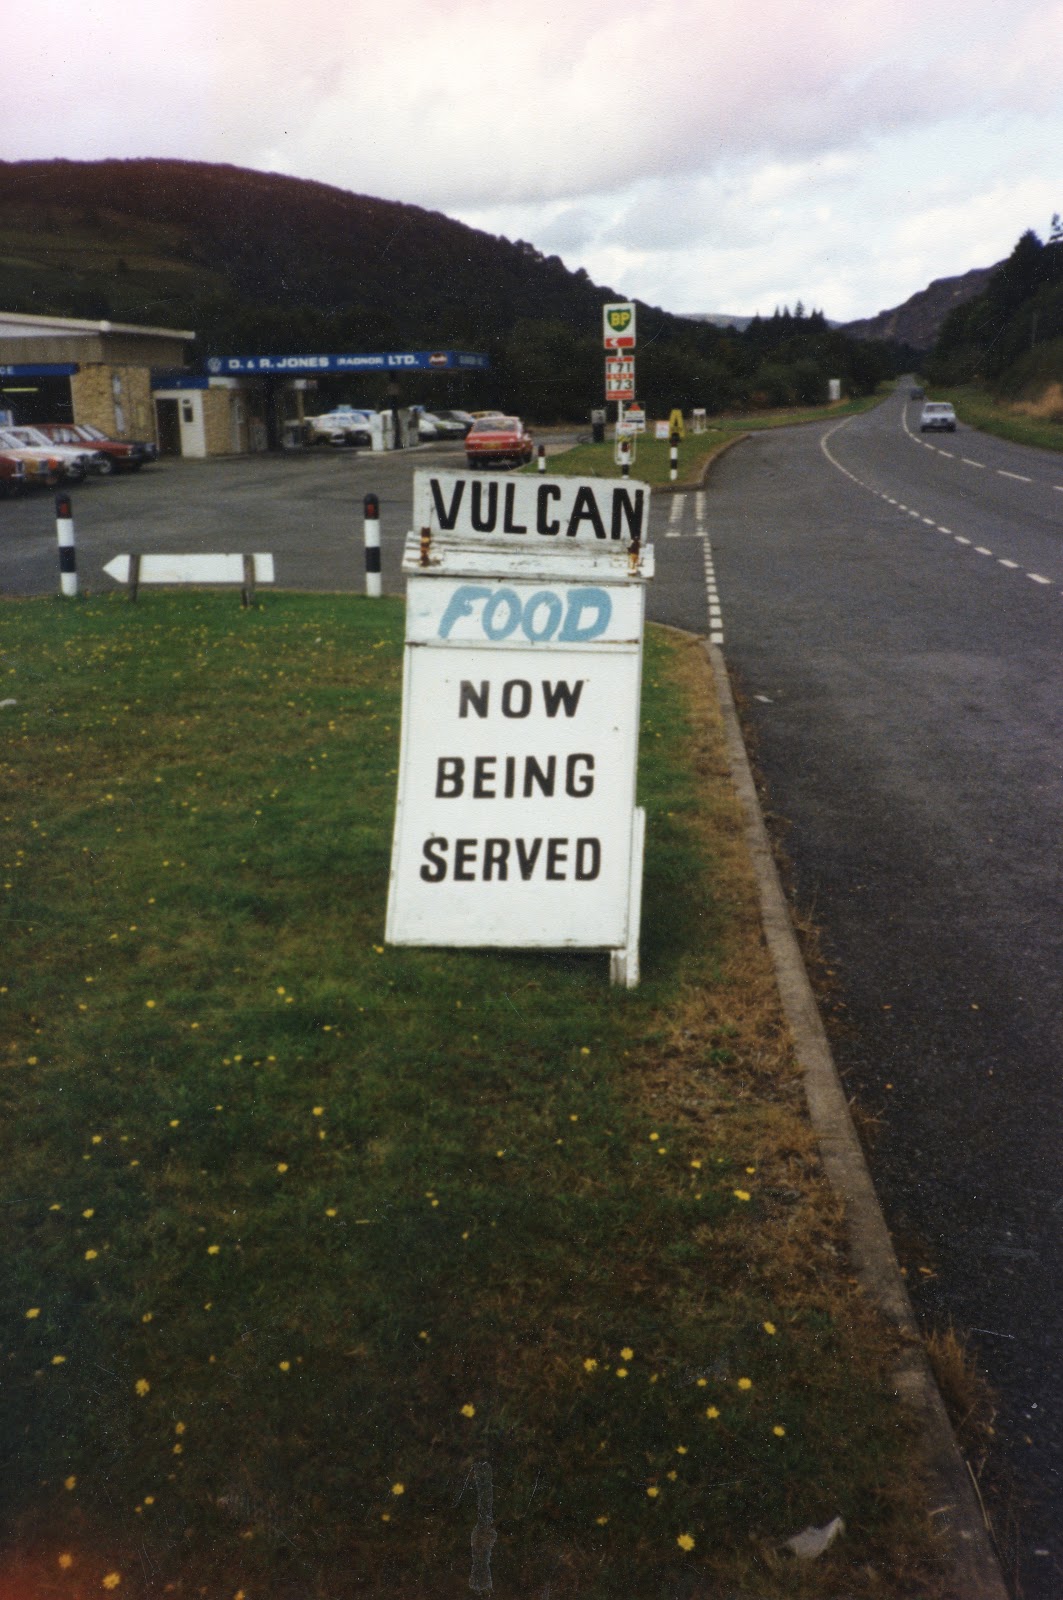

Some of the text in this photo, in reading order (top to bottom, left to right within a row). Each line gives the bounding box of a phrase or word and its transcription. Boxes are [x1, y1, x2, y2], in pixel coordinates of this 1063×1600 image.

[610, 312, 630, 326] BP
[247, 360, 255, 369] &
[276, 356, 330, 368] JONES
[388, 354, 420, 365] LTD.
[608, 362, 631, 373] 171
[608, 379, 632, 390] 173
[430, 478, 645, 540] VULCAN
[438, 586, 612, 642] FOOD
[458, 679, 584, 719] NOW
[435, 753, 595, 799] BEING
[419, 836, 602, 883] SERVED
